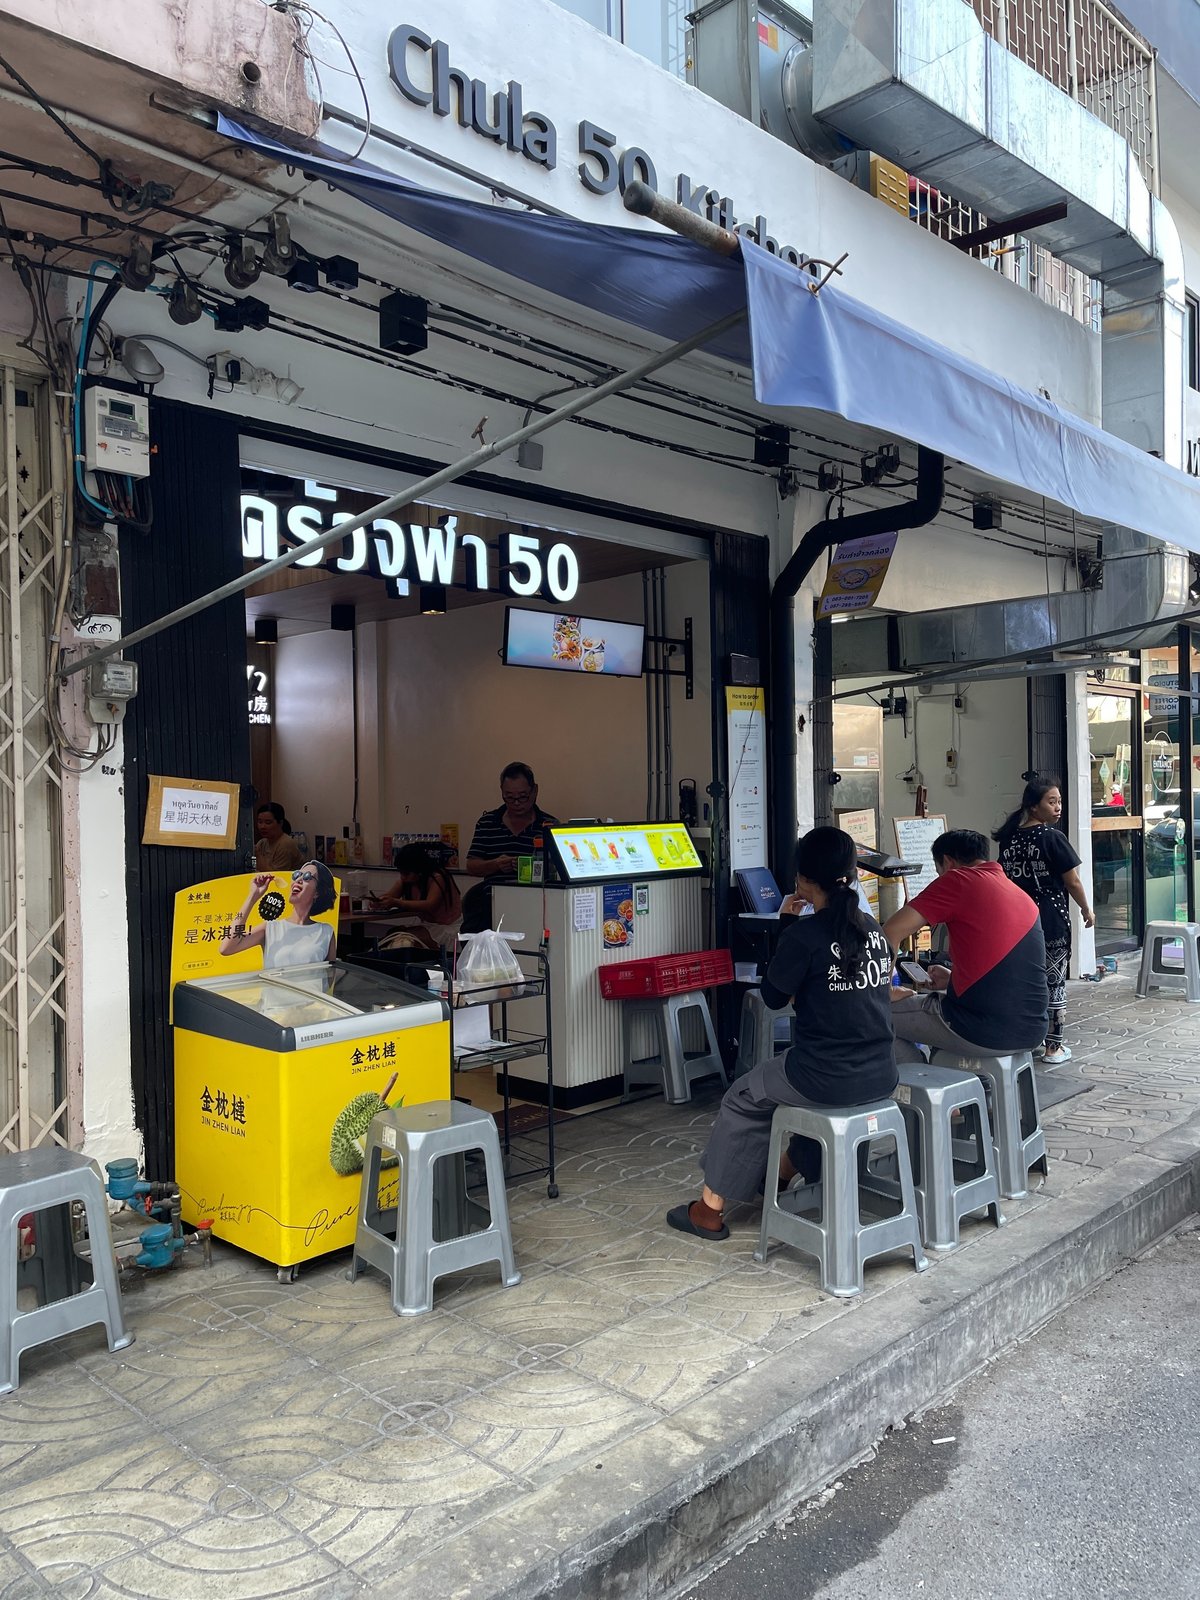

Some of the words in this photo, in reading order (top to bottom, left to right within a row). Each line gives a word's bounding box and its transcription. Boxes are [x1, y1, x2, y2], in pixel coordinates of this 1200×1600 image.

[387, 23, 557, 171] Chula
[578, 119, 658, 197] 50
[507, 532, 580, 602] 50
[164, 810, 223, 827] 星期天休息
[266, 895, 283, 908] 100%
[193, 911, 243, 924] 不是冰淇淋
[828, 981, 854, 992] CHULA
[300, 1031, 334, 1043] LIEBHERR
[351, 1067, 362, 1075] JIN
[363, 1063, 380, 1072] ZHEN
[382, 1060, 396, 1068] LIAN
[201, 1115, 211, 1127] JIN
[212, 1119, 229, 1133] ZHEN
[231, 1126, 246, 1138] LIAN
